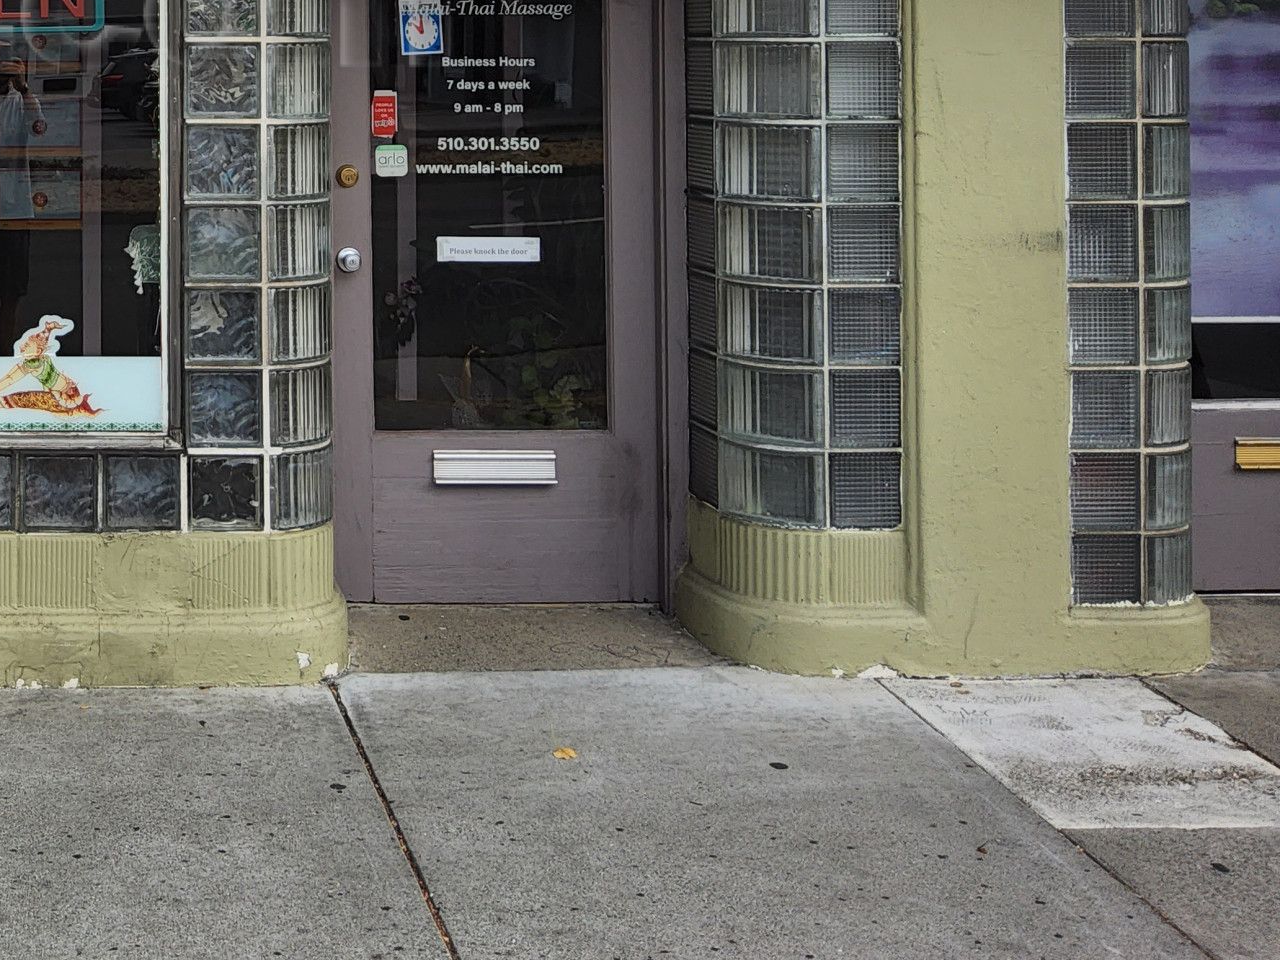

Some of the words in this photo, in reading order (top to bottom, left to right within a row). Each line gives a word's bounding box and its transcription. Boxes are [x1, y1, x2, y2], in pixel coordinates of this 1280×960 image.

[498, 0, 573, 20] Massage
[441, 56, 496, 67] Business
[499, 56, 536, 67] Hours
[447, 80, 454, 90] 7
[456, 79, 485, 92] days
[488, 81, 495, 90] a
[498, 79, 531, 90] week
[453, 103, 461, 113] 9
[464, 104, 483, 113] am
[494, 103, 502, 113] 8
[504, 104, 524, 116] pm
[437, 137, 540, 151] 510.301.3550
[378, 153, 405, 165] arlo
[415, 161, 563, 174] www.malai-thai.com
[449, 247, 472, 255] Please
[497, 247, 509, 255] the
[511, 247, 528, 255] door
